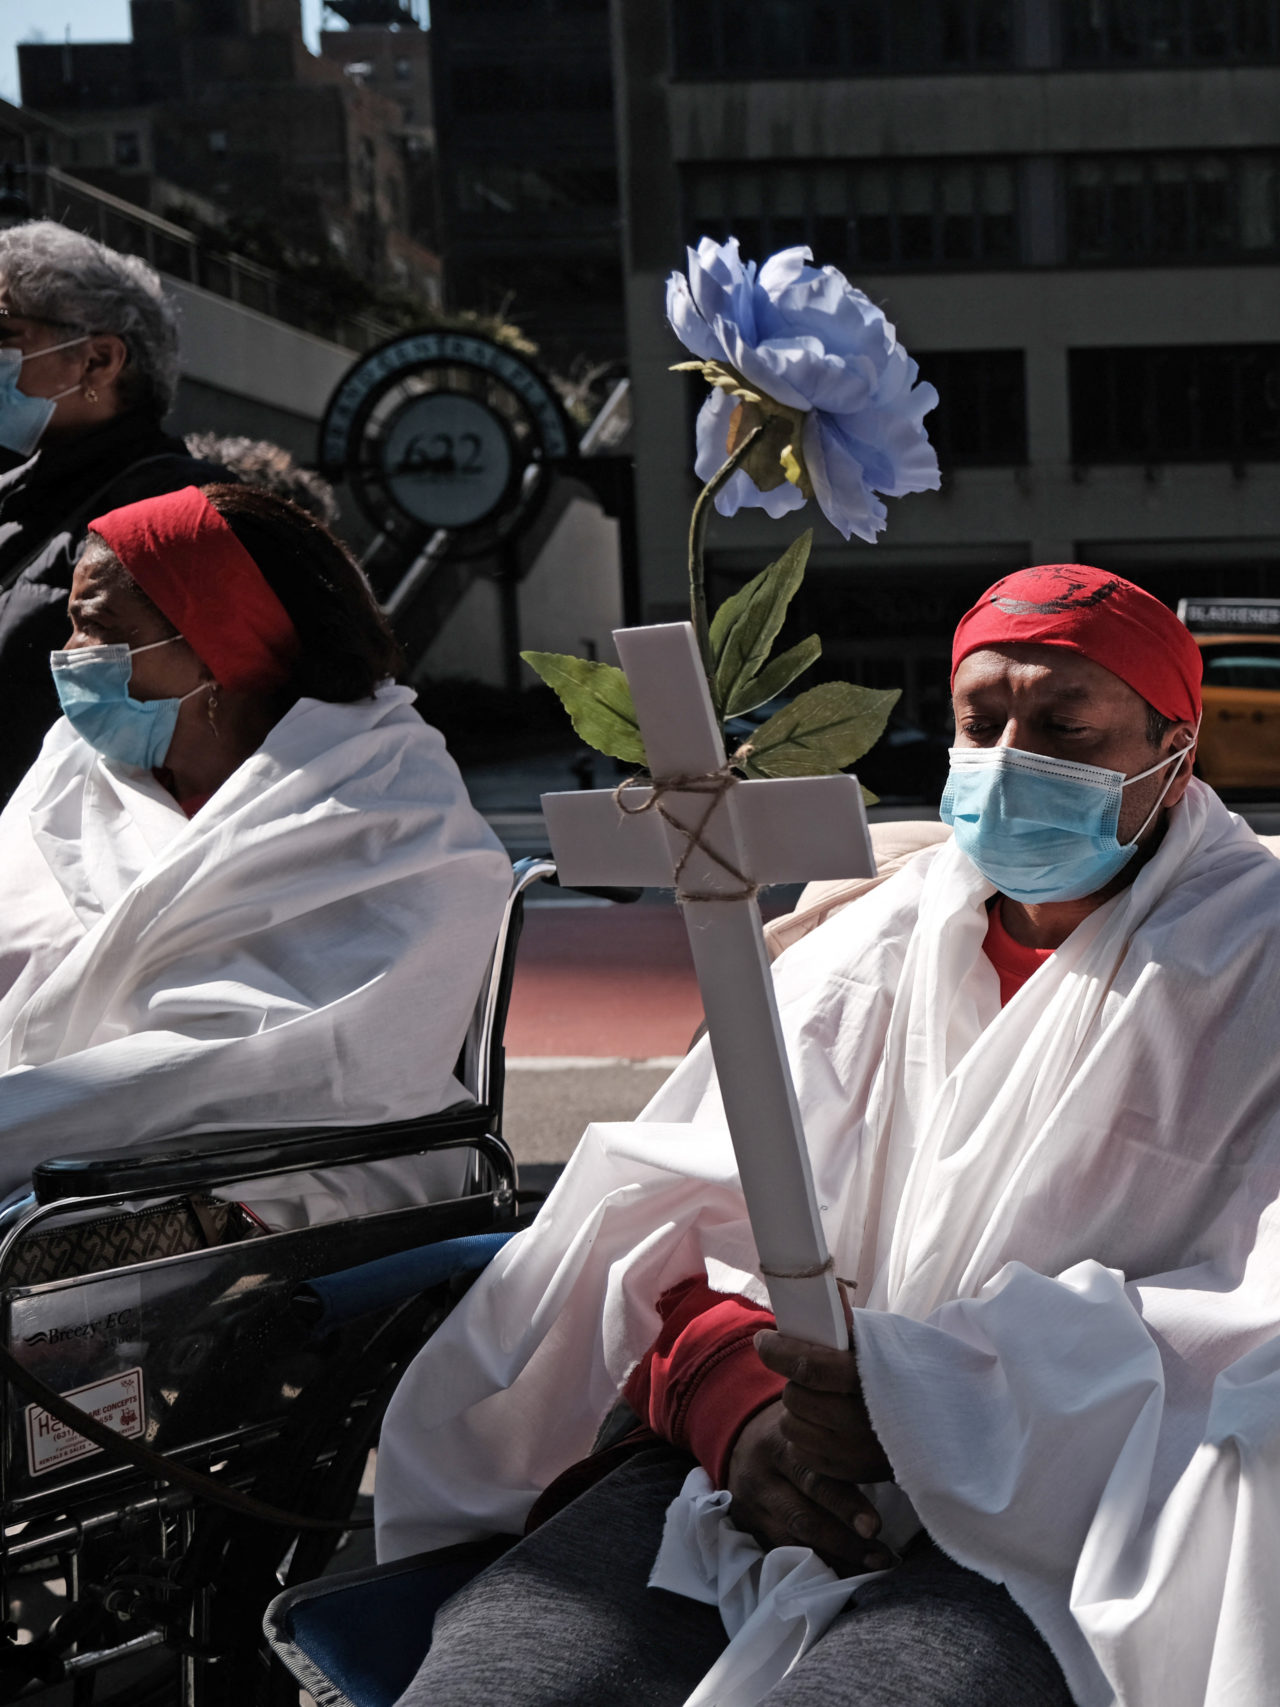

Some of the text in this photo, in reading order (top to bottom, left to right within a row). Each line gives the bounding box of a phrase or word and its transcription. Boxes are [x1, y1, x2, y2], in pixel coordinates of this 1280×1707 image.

[48, 1309, 132, 1345] Breezy EC
[102, 1395, 137, 1413] CONCEPTS
[53, 1429, 75, 1442] (631)
[69, 1444, 86, 1455] SALES
